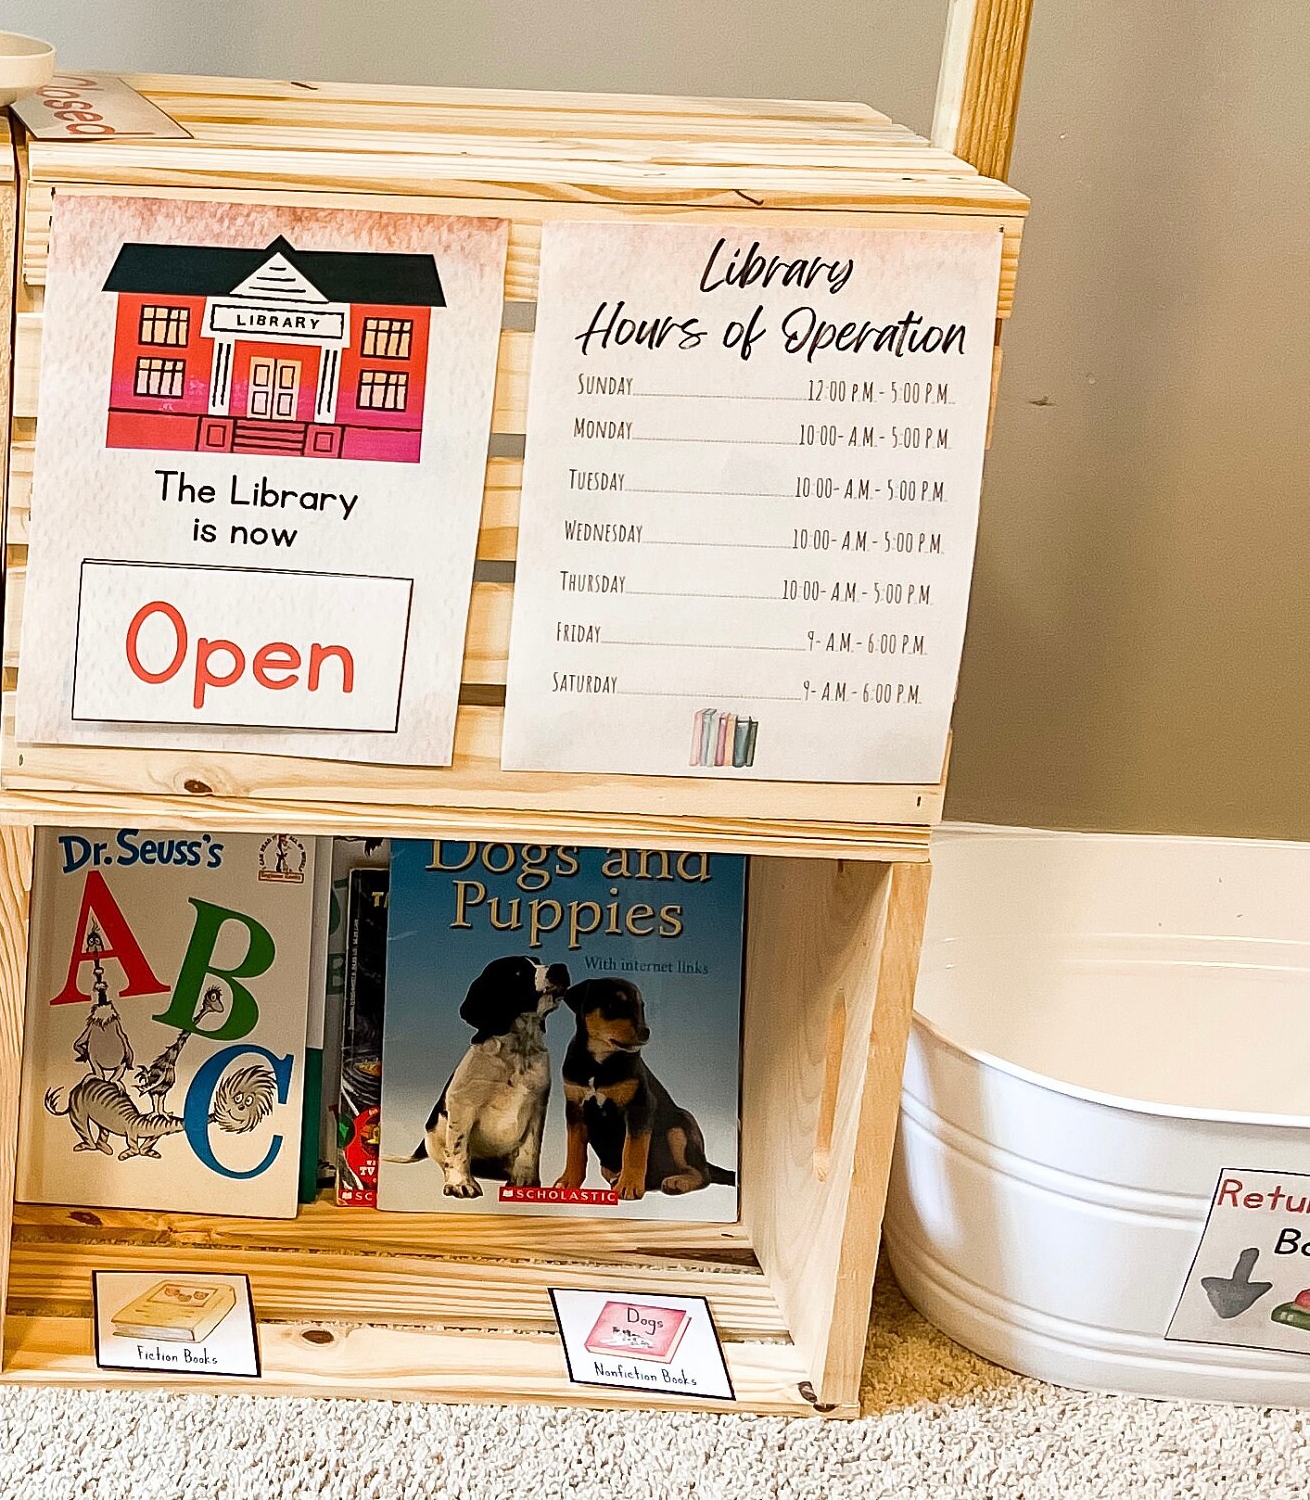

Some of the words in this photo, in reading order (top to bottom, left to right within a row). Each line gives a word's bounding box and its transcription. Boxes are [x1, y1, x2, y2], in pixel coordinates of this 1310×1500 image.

[698, 237, 855, 295] Library
[236, 313, 320, 330] LIBRARY
[574, 300, 708, 356] Hours
[722, 304, 767, 361] of
[782, 305, 966, 364] Operation
[577, 372, 634, 396] SUNDAY
[808, 379, 847, 402] 12:00
[891, 381, 920, 404] 5:00
[573, 417, 633, 440] MONDAY
[892, 426, 921, 449] 5:00
[154, 469, 217, 505] The
[230, 473, 359, 520] Library
[569, 468, 625, 491] TUESDAY
[887, 478, 916, 502] 5:00
[192, 517, 217, 544] is
[230, 524, 299, 548] now
[564, 519, 643, 543] WEDNESDAY
[884, 531, 913, 553] 5:00
[559, 570, 626, 594] THURSDAY
[873, 582, 903, 605] 5:00
[125, 599, 355, 710] Open
[556, 621, 601, 643] FRIDAY
[867, 632, 897, 655] 6:00
[551, 671, 618, 694] SATURDAY
[862, 682, 892, 704] 6:00
[58, 834, 112, 874] Dr.
[116, 827, 225, 869] Seuss's
[425, 840, 580, 891] Dogs
[601, 845, 713, 884] and
[449, 879, 686, 959] Puppies
[584, 955, 618, 972] With
[620, 957, 673, 974] internet
[676, 959, 710, 975] links
[515, 1188, 617, 1202] SCHOLASTIC
[1216, 1178, 1310, 1215] Retu
[627, 1307, 664, 1336] Dogs
[136, 1345, 178, 1362] Fiction
[183, 1347, 218, 1365] Books
[593, 1361, 658, 1381] Nonfiction
[661, 1368, 698, 1386] Books
